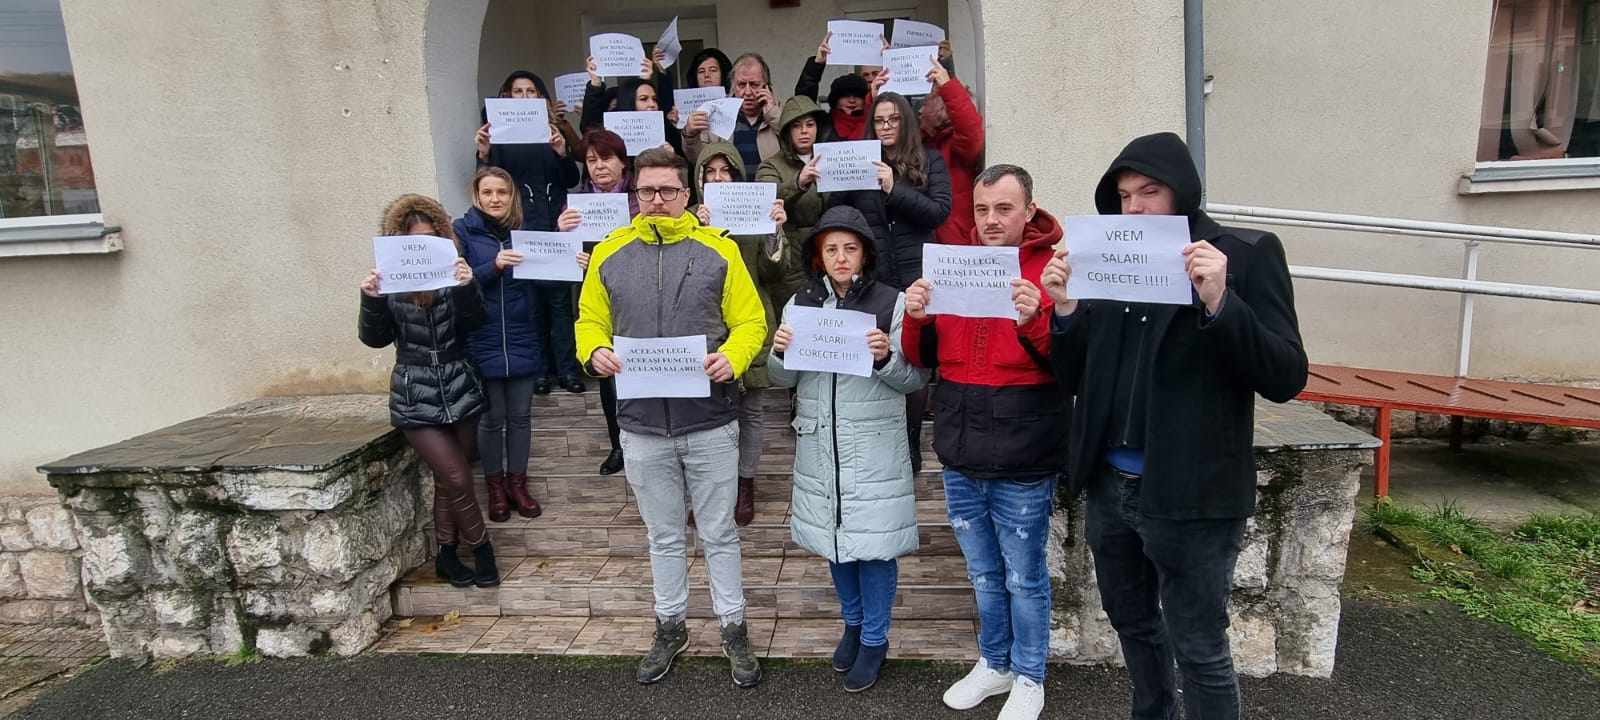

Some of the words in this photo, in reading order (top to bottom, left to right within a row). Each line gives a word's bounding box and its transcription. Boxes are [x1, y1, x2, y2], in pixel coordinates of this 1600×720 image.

[1105, 230, 1144, 241] VREM
[401, 243, 427, 252] VREM
[400, 256, 432, 266] SALARII
[1101, 252, 1148, 265] SALARII
[390, 272, 428, 281] CORECTE
[1087, 271, 1142, 285] CORECTE
[1144, 274, 1169, 287] !!!!!
[817, 318, 844, 328] VREM
[811, 334, 847, 345] SALARII
[799, 348, 839, 360] CORECTE
